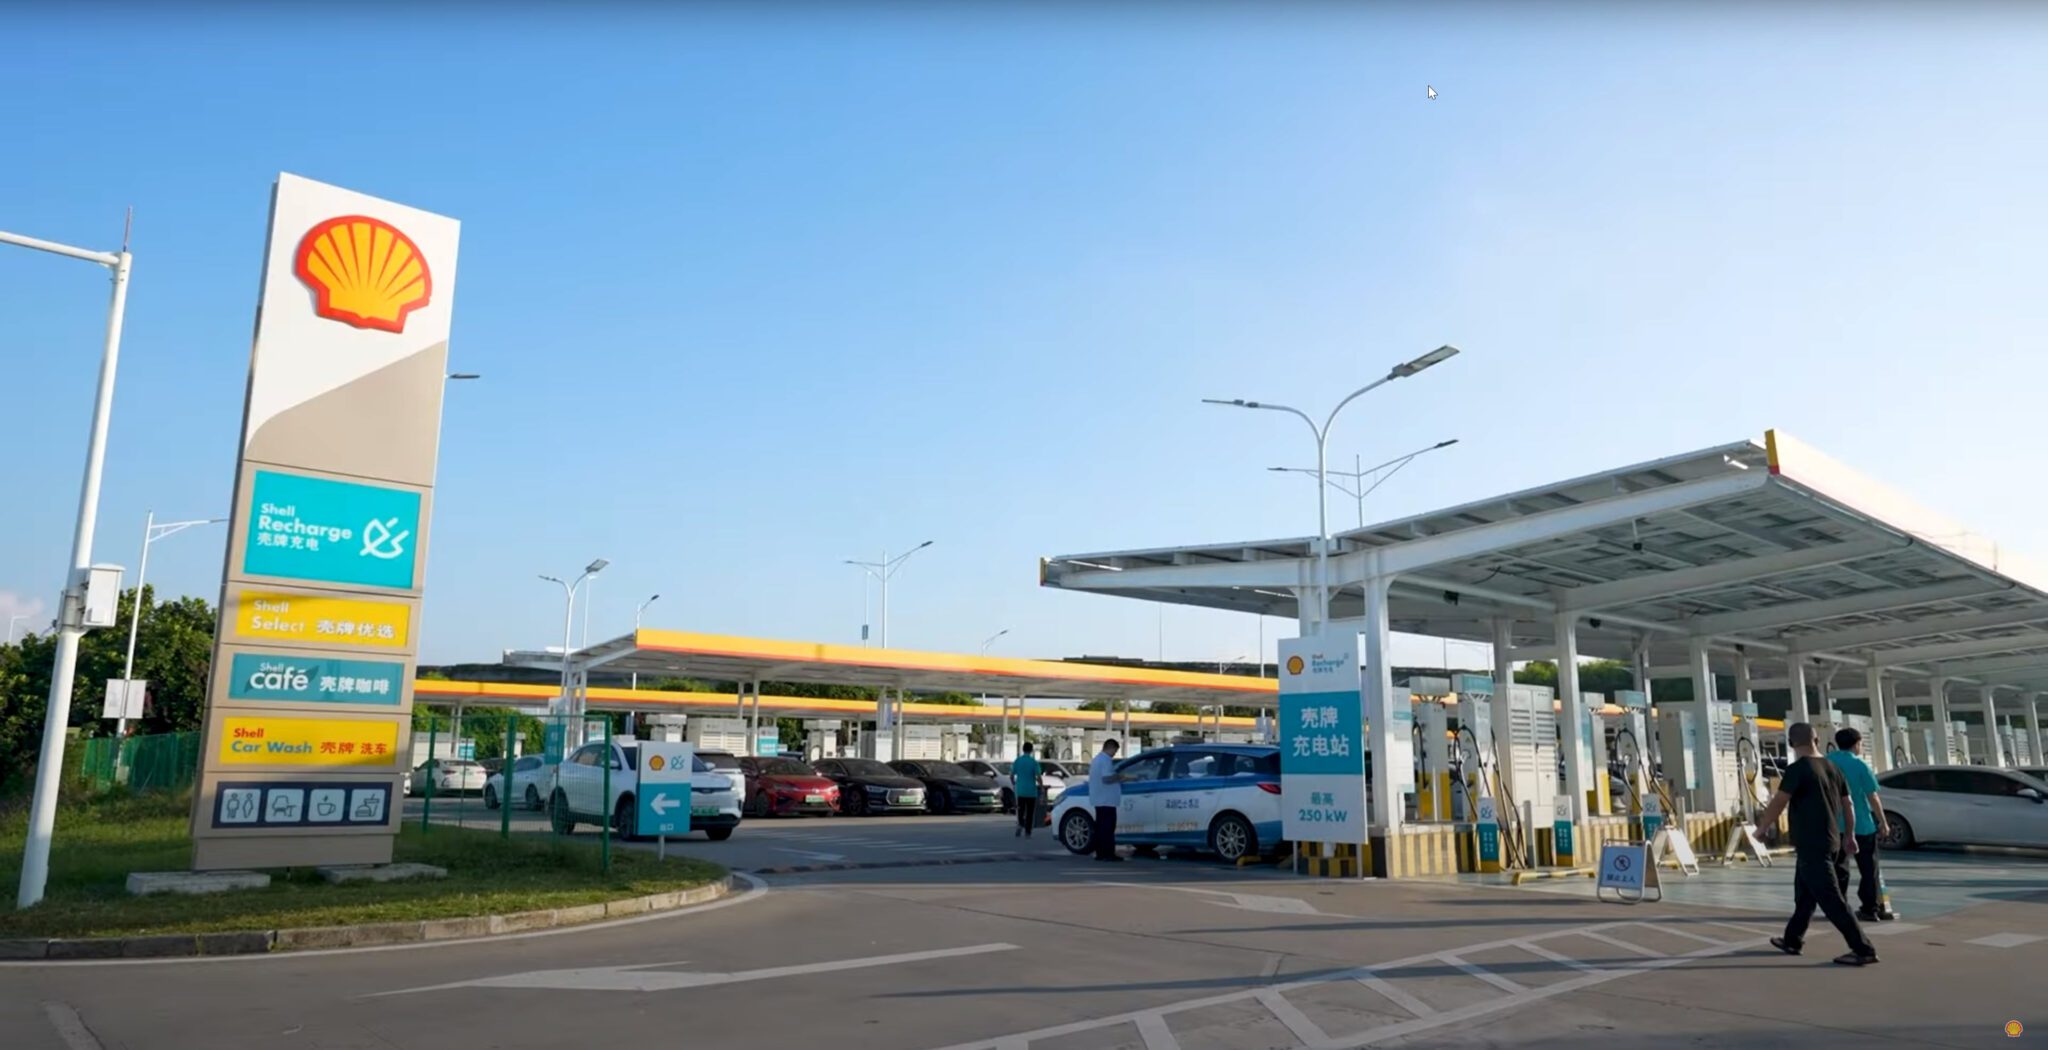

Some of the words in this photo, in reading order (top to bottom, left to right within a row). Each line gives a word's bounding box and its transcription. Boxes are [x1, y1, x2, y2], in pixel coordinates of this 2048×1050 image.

[261, 503, 295, 517] Shell
[258, 515, 352, 542] Recharge
[257, 532, 319, 551] 壳牌充电
[254, 600, 289, 612] Shell
[252, 616, 304, 632] Select
[317, 619, 394, 638] 壳牌优选
[260, 662, 284, 672] Shell
[250, 666, 308, 691] café
[320, 676, 389, 695] 壳牌咖啡
[1301, 706, 1339, 729] 壳牌
[233, 728, 264, 738] Shell
[231, 740, 260, 752] Car
[267, 741, 312, 753] Wash
[320, 742, 355, 754] 壳牌
[360, 742, 387, 755] 洗车
[1293, 734, 1350, 757] 充电站
[1298, 809, 1322, 822] 250
[1325, 809, 1347, 822] kW
